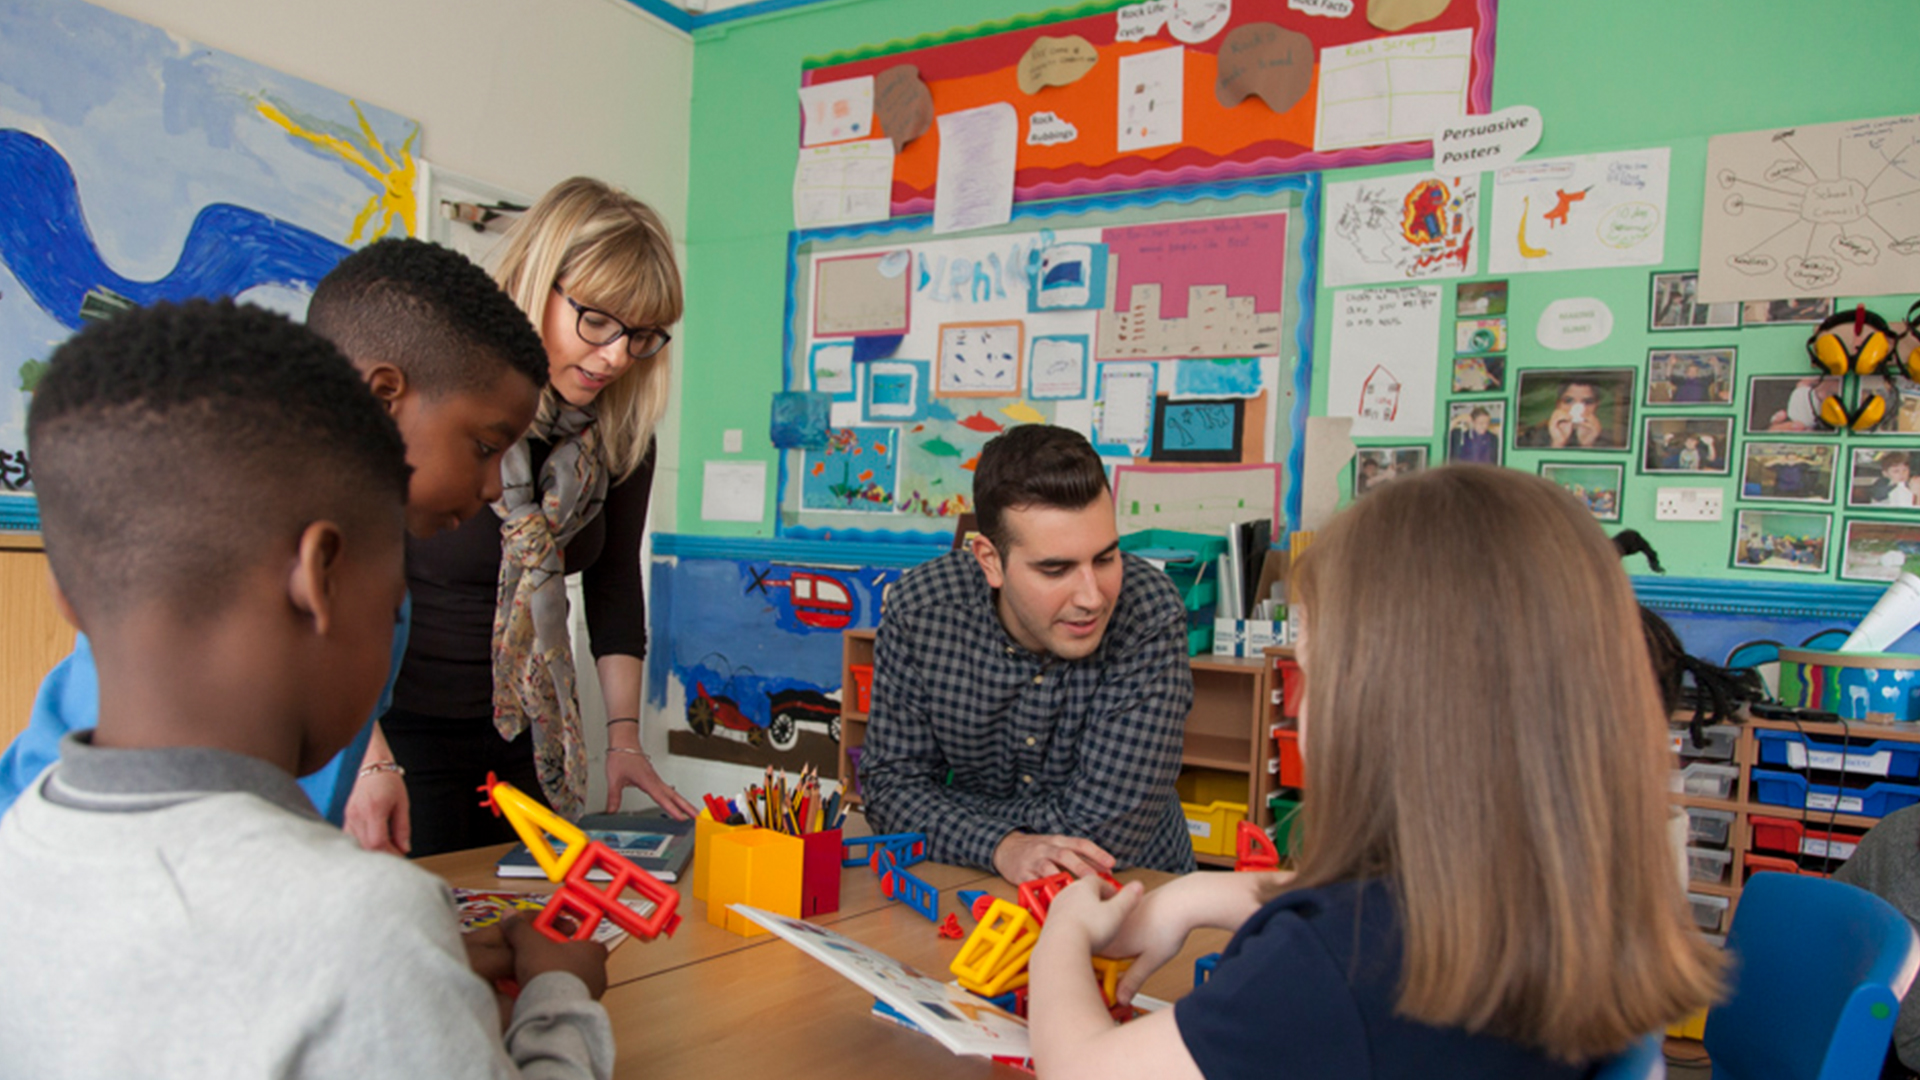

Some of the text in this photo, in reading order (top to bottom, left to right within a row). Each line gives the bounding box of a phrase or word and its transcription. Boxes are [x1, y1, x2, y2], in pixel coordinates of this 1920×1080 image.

[1121, 6, 1144, 19] Rock
[1031, 113, 1054, 125] Rock
[1030, 129, 1074, 143] Rubbings
[1442, 116, 1530, 142] Persuasive
[1442, 144, 1502, 165] Posters
